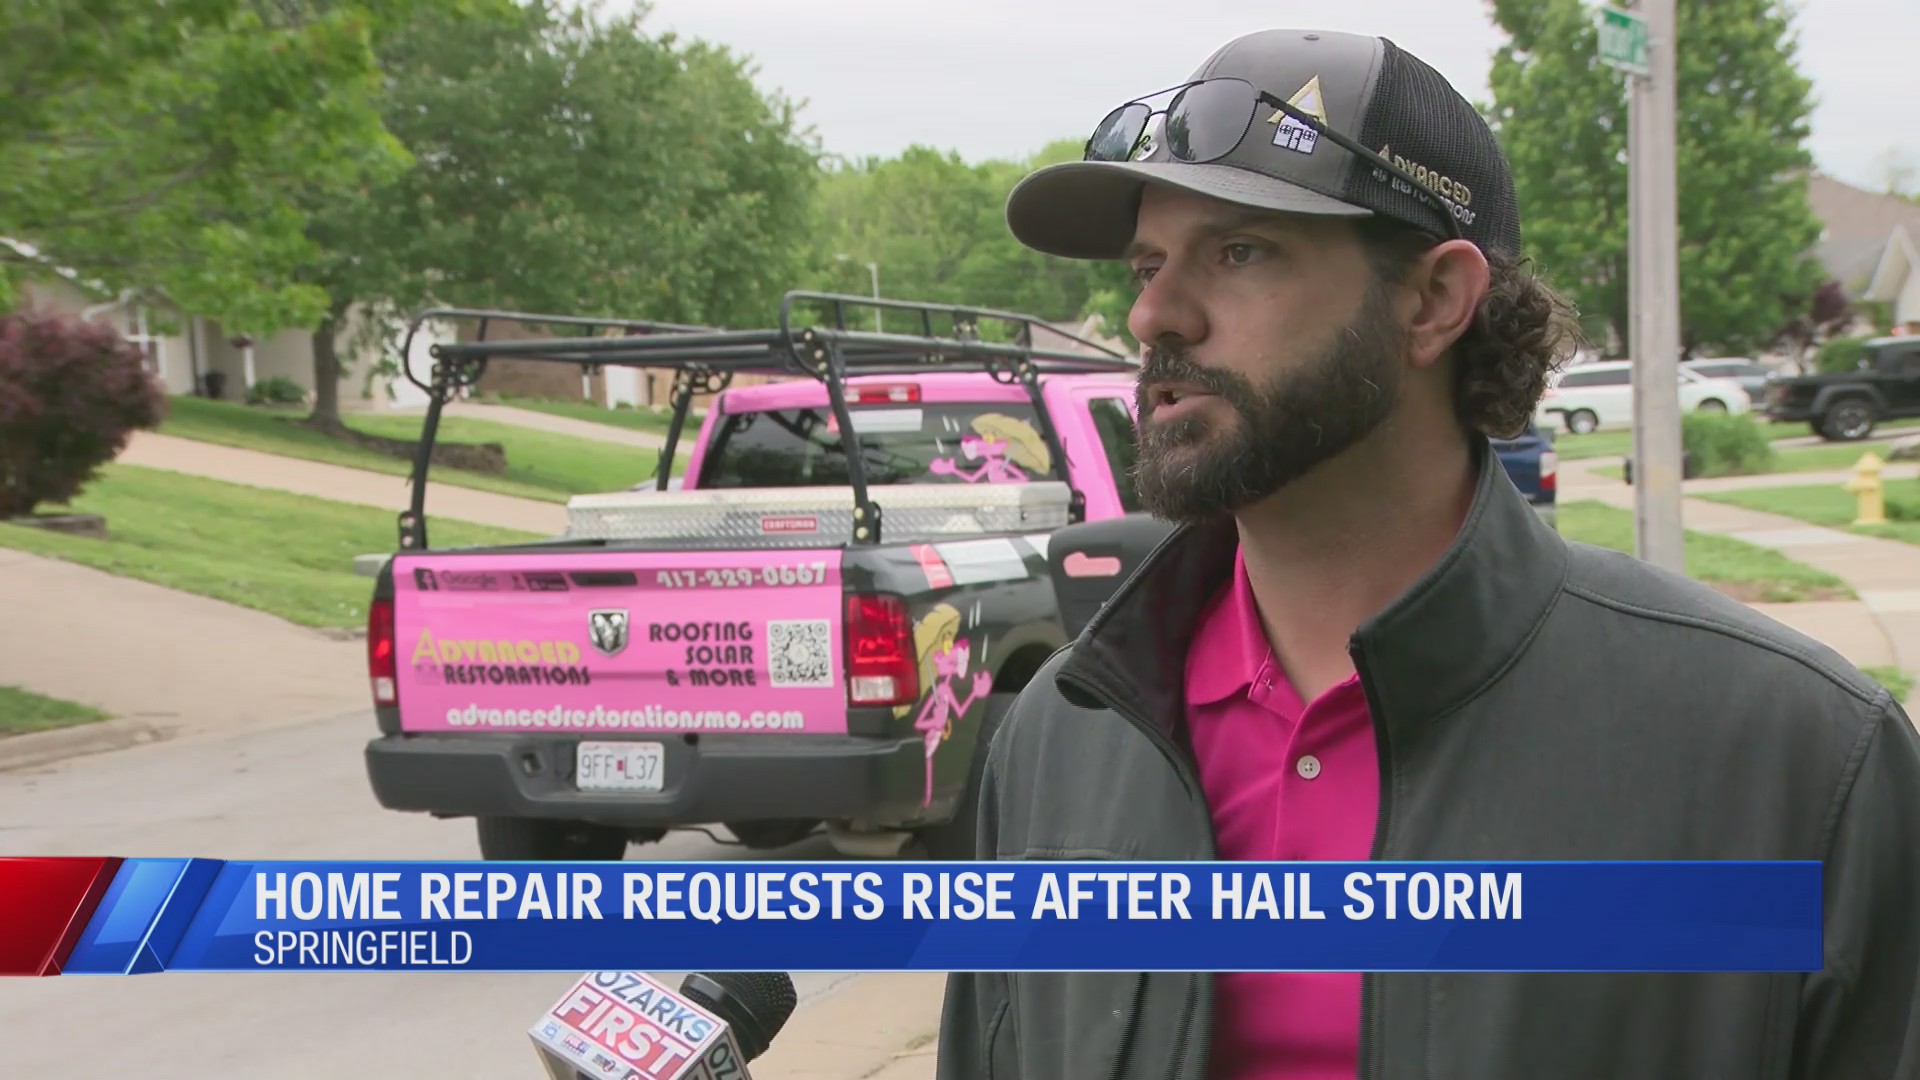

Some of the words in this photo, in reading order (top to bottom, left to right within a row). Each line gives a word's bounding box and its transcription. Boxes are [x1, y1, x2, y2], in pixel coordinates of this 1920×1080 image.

[656, 561, 827, 588] 417-229-0667
[649, 622, 753, 641] ROOFING
[685, 646, 754, 664] SOLAR
[444, 664, 591, 685] RESTORATIONS
[689, 669, 757, 686] MORE
[446, 703, 805, 729] advancedrestorationsmo.com
[581, 754, 615, 779] 9FF
[624, 755, 658, 780] L37
[594, 972, 713, 1043] OZARKS
[556, 990, 691, 1075] FIRST
